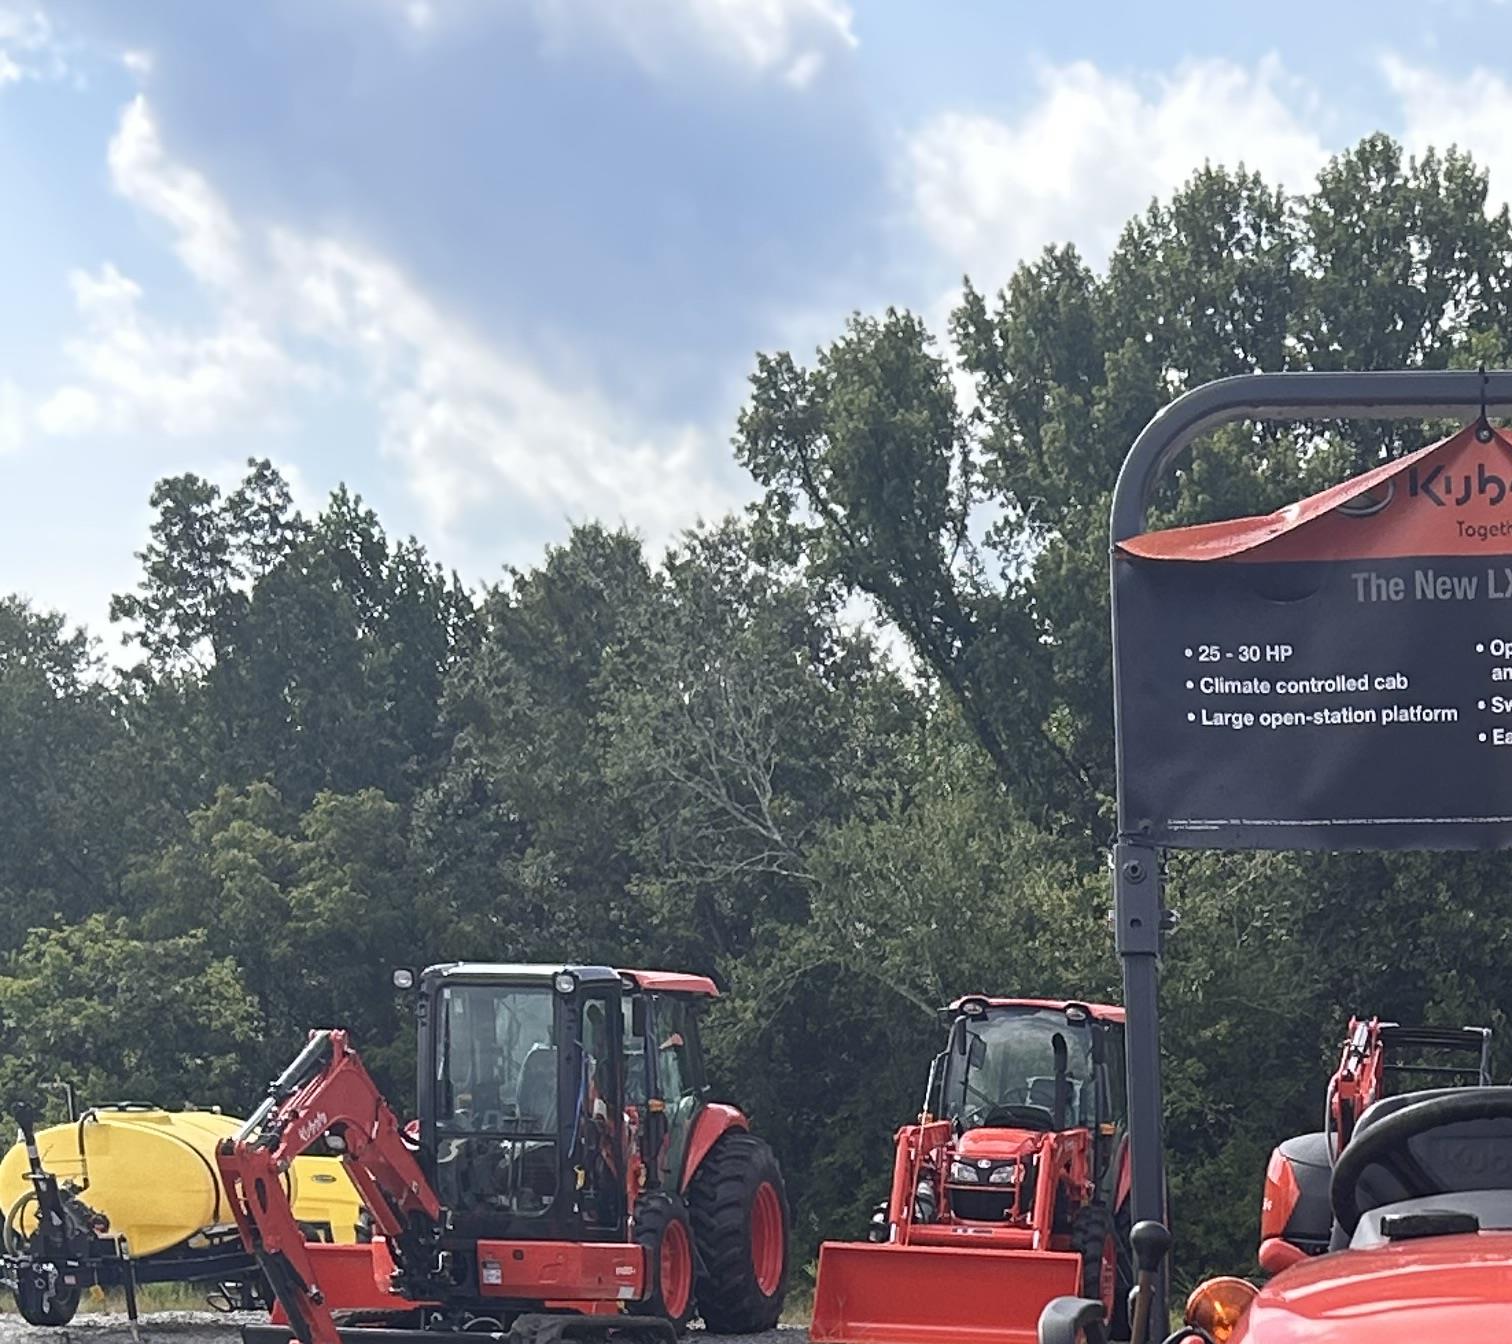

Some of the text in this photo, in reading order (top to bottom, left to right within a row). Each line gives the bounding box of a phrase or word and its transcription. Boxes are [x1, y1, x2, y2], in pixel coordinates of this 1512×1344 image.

[1351, 572, 1406, 602] The
[1414, 569, 1479, 601] New
[1198, 645, 1221, 662] 25
[1238, 645, 1261, 662] 30
[1265, 645, 1293, 662] HP
[1199, 672, 1409, 694] Climate controlled cab
[1201, 704, 1459, 729] Large open-station platform
